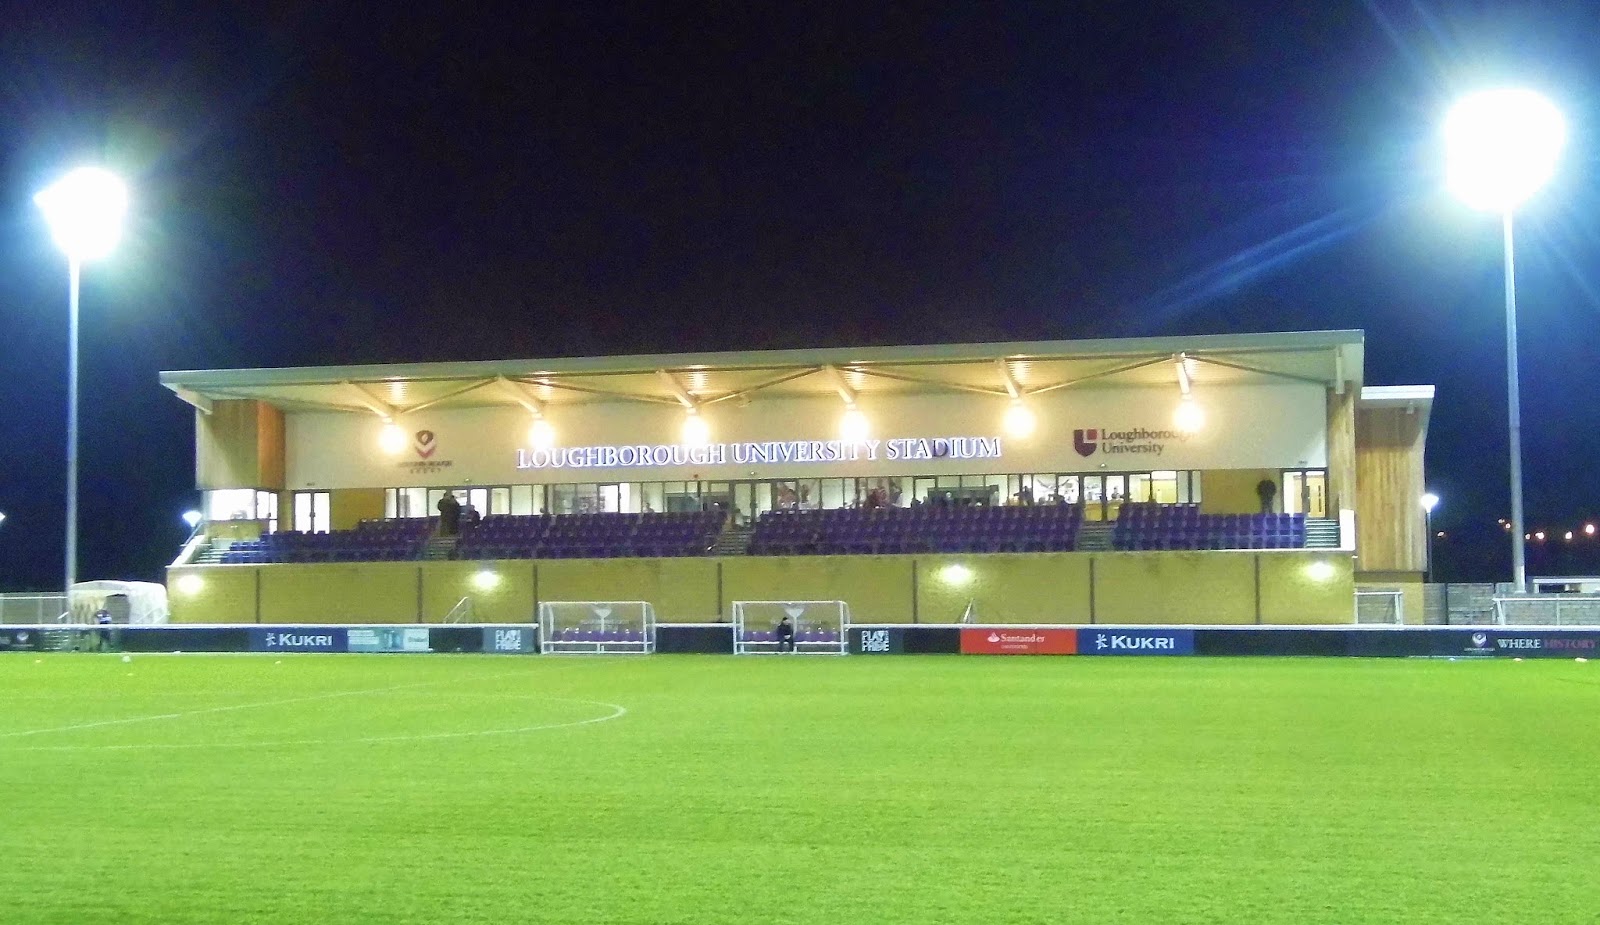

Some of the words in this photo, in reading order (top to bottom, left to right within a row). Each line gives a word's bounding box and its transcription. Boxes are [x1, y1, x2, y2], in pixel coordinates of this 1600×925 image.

[516, 443, 727, 469] LOUGHBOROUGH
[731, 439, 881, 464] UNIVERSITY
[886, 436, 1002, 460] STADIUM
[1102, 442, 1165, 457] University
[278, 633, 334, 647] KUKRI
[1000, 633, 1046, 643] Santander
[1111, 635, 1176, 650] KUKRI
[1497, 638, 1542, 649] WHERE
